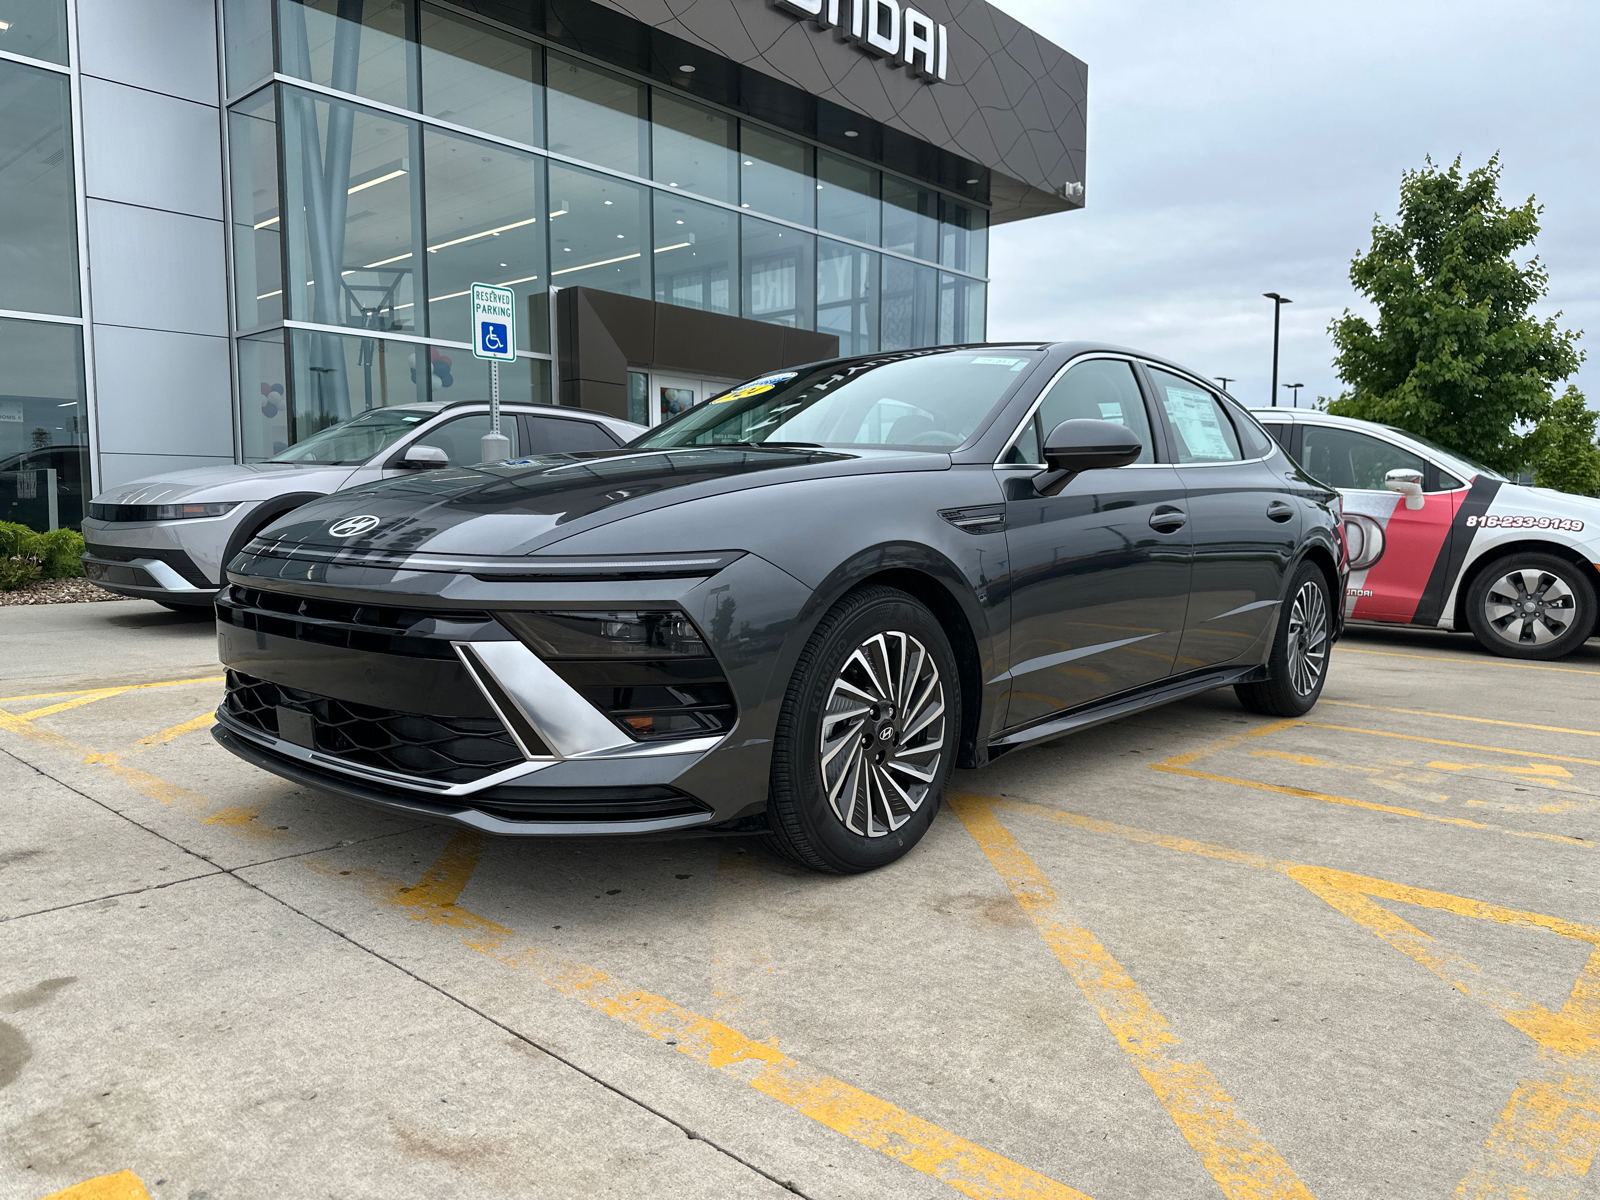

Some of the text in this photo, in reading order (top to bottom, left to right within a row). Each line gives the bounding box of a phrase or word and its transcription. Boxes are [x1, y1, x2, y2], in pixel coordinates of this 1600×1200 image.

[475, 290, 510, 305] RESERVED
[475, 303, 511, 318] PARKING
[1465, 515, 1584, 532] 816-233-9149
[810, 638, 848, 713] KUMHO
